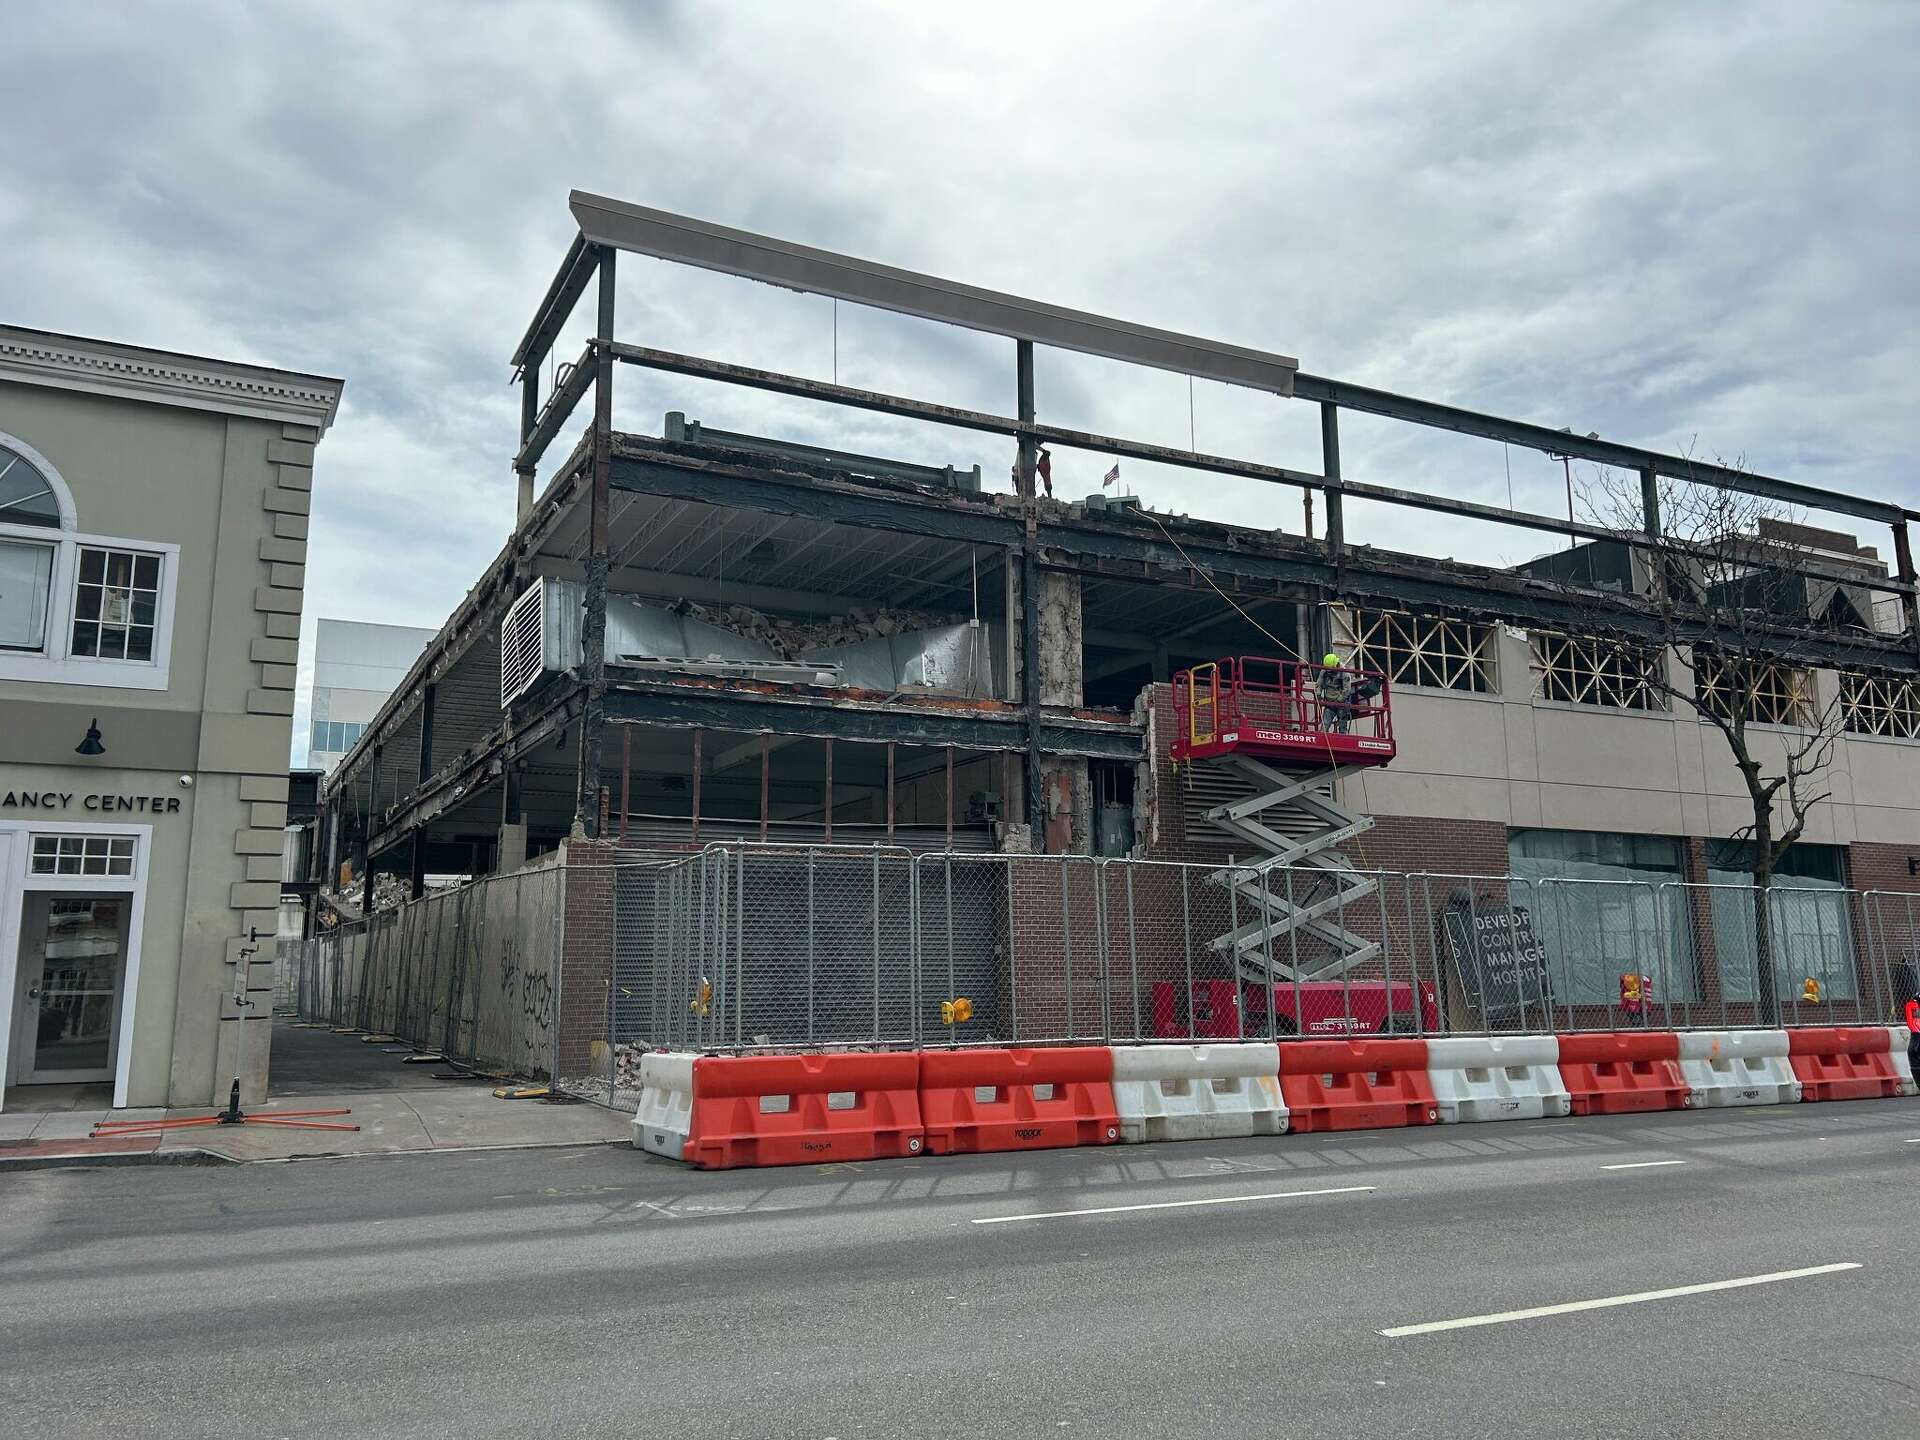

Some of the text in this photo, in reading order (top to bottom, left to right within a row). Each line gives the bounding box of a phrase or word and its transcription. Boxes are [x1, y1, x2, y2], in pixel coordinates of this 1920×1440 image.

[1256, 730, 1316, 743] mec 3369 RT
[2, 791, 181, 813] ANCY CENTER
[1359, 1022, 1371, 1030] RT
